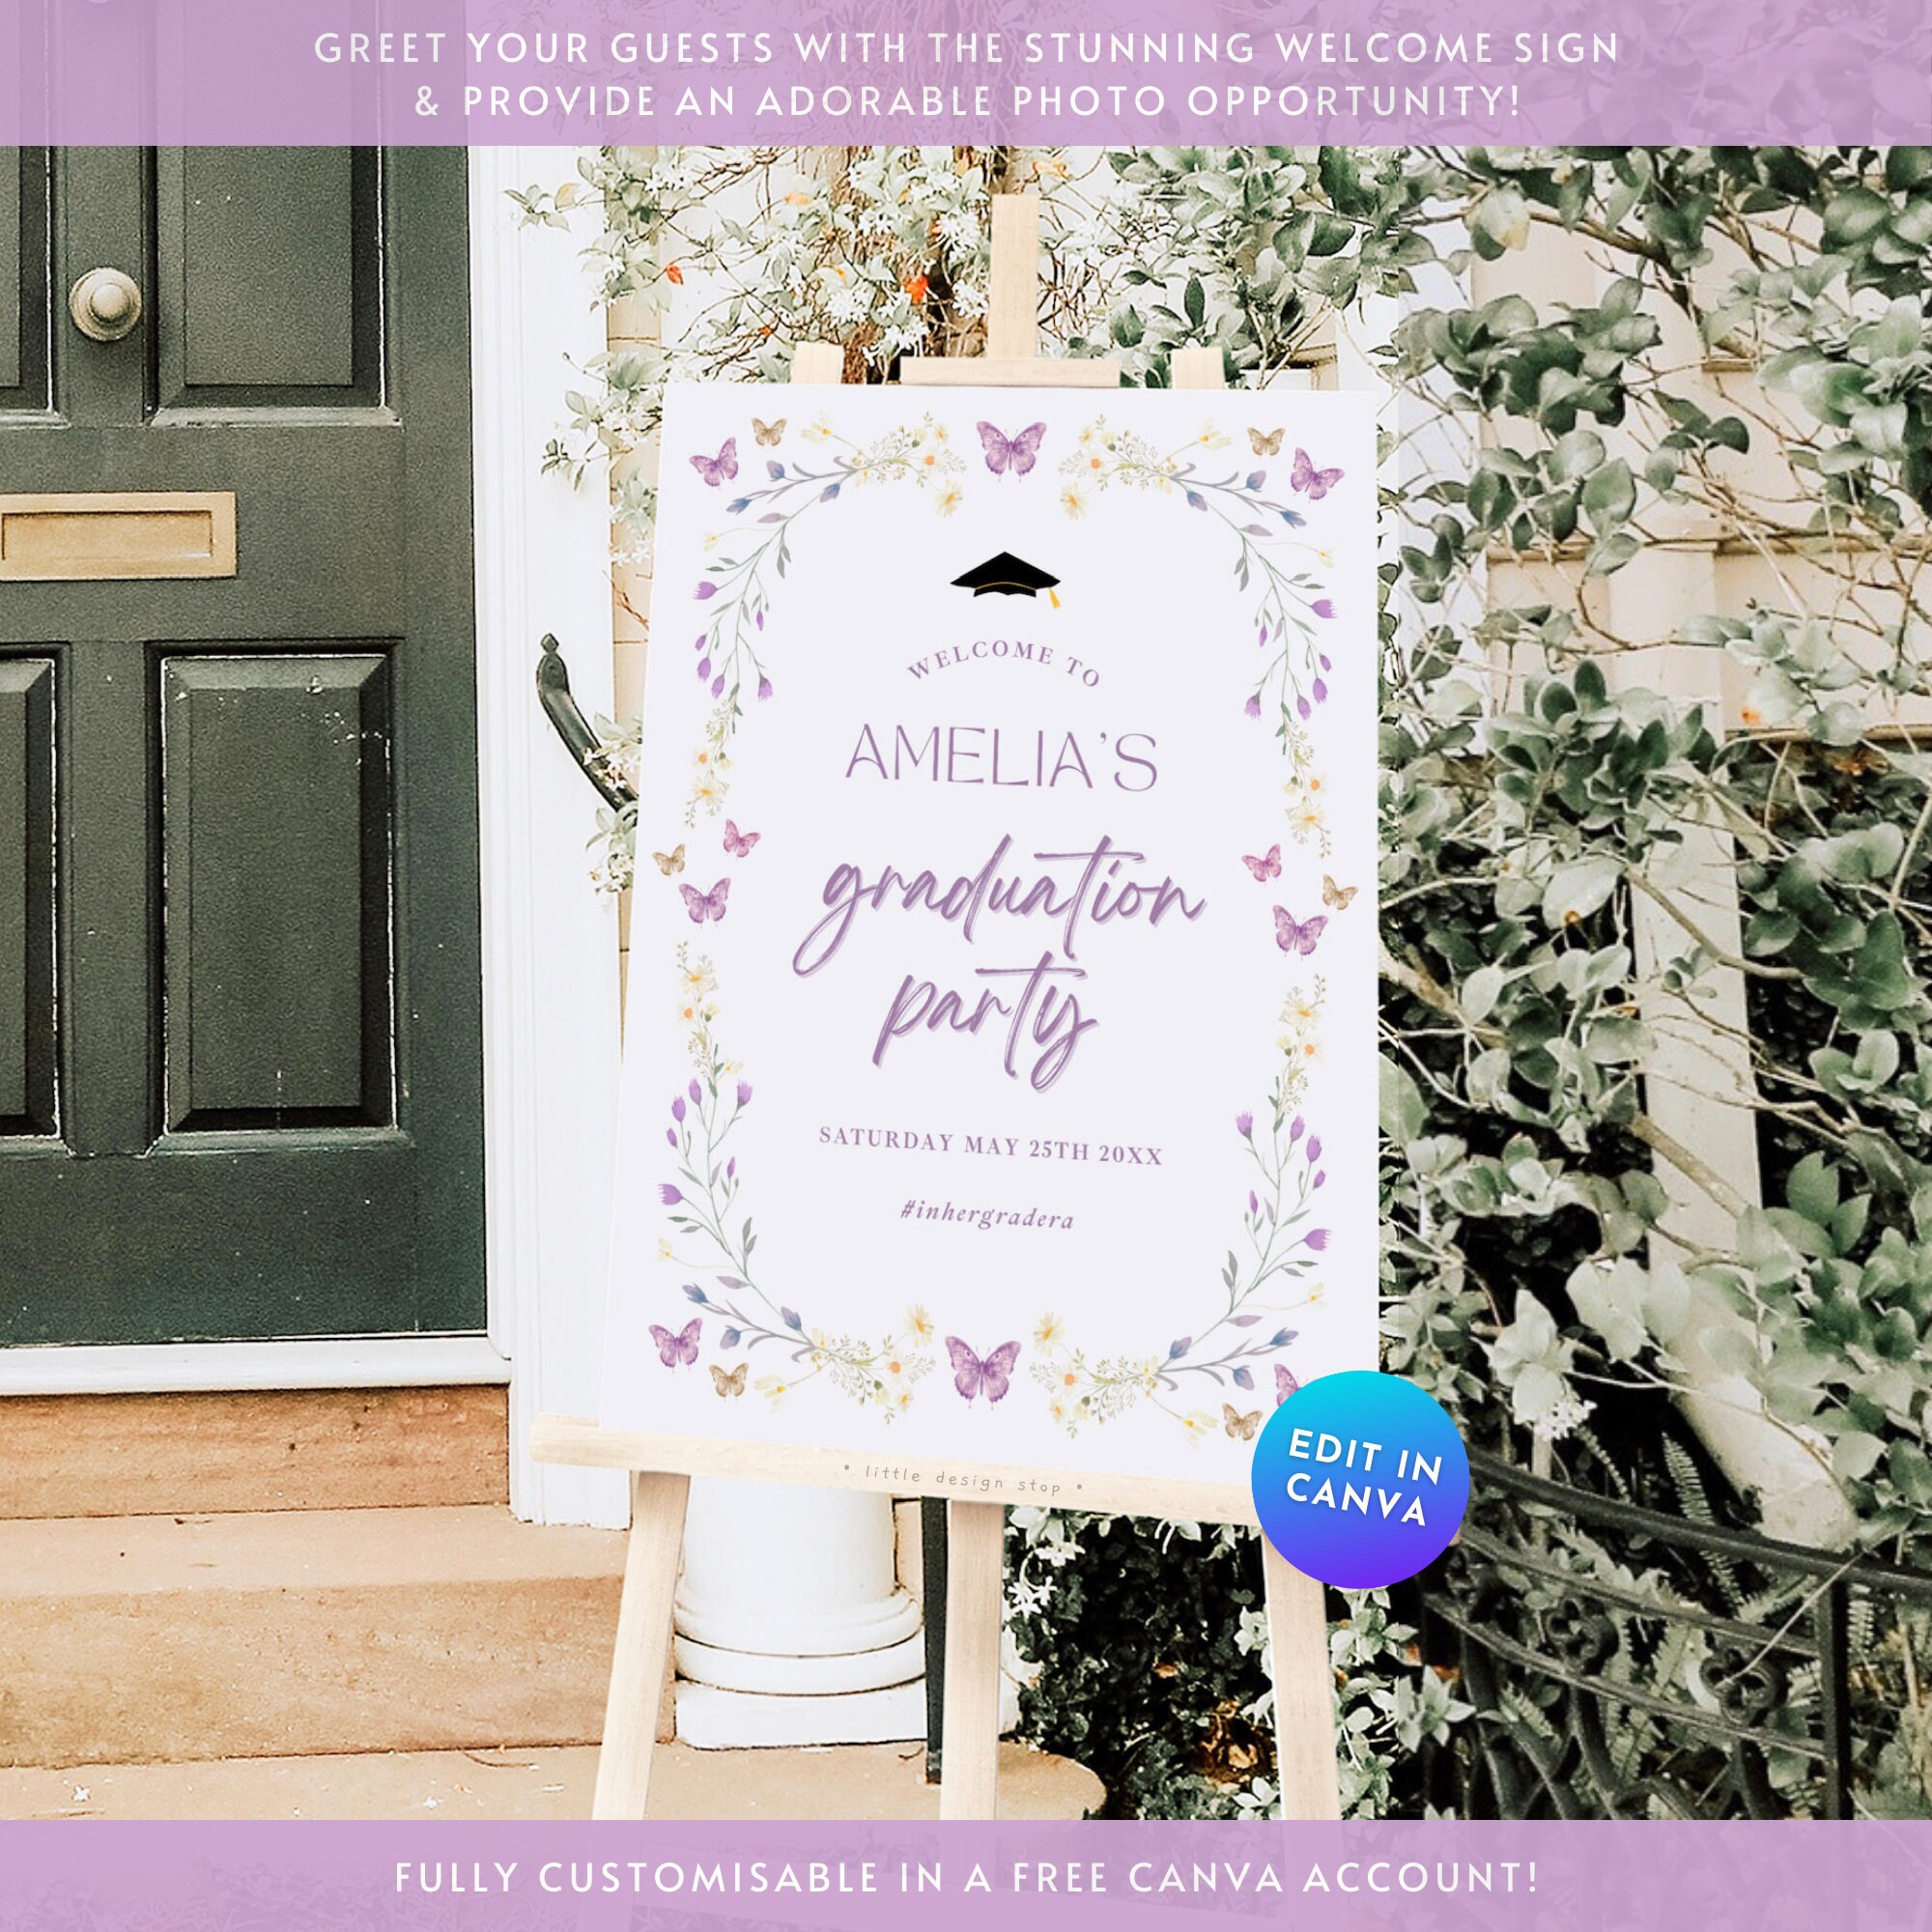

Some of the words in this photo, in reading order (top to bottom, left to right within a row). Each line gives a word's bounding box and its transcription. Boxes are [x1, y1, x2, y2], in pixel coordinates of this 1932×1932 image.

[907, 639, 1054, 680] WELCOME
[1065, 656, 1100, 688] TO
[844, 723, 1158, 792] AMELIA'S
[792, 833, 1208, 979] graduation
[871, 950, 1099, 1094] party
[819, 1125, 954, 1152] SATURDAY
[963, 1135, 1020, 1156] MAY
[1029, 1139, 1090, 1161] 25TH
[1098, 1144, 1163, 1166] 20XX
[899, 1199, 1074, 1231] #inhergradera
